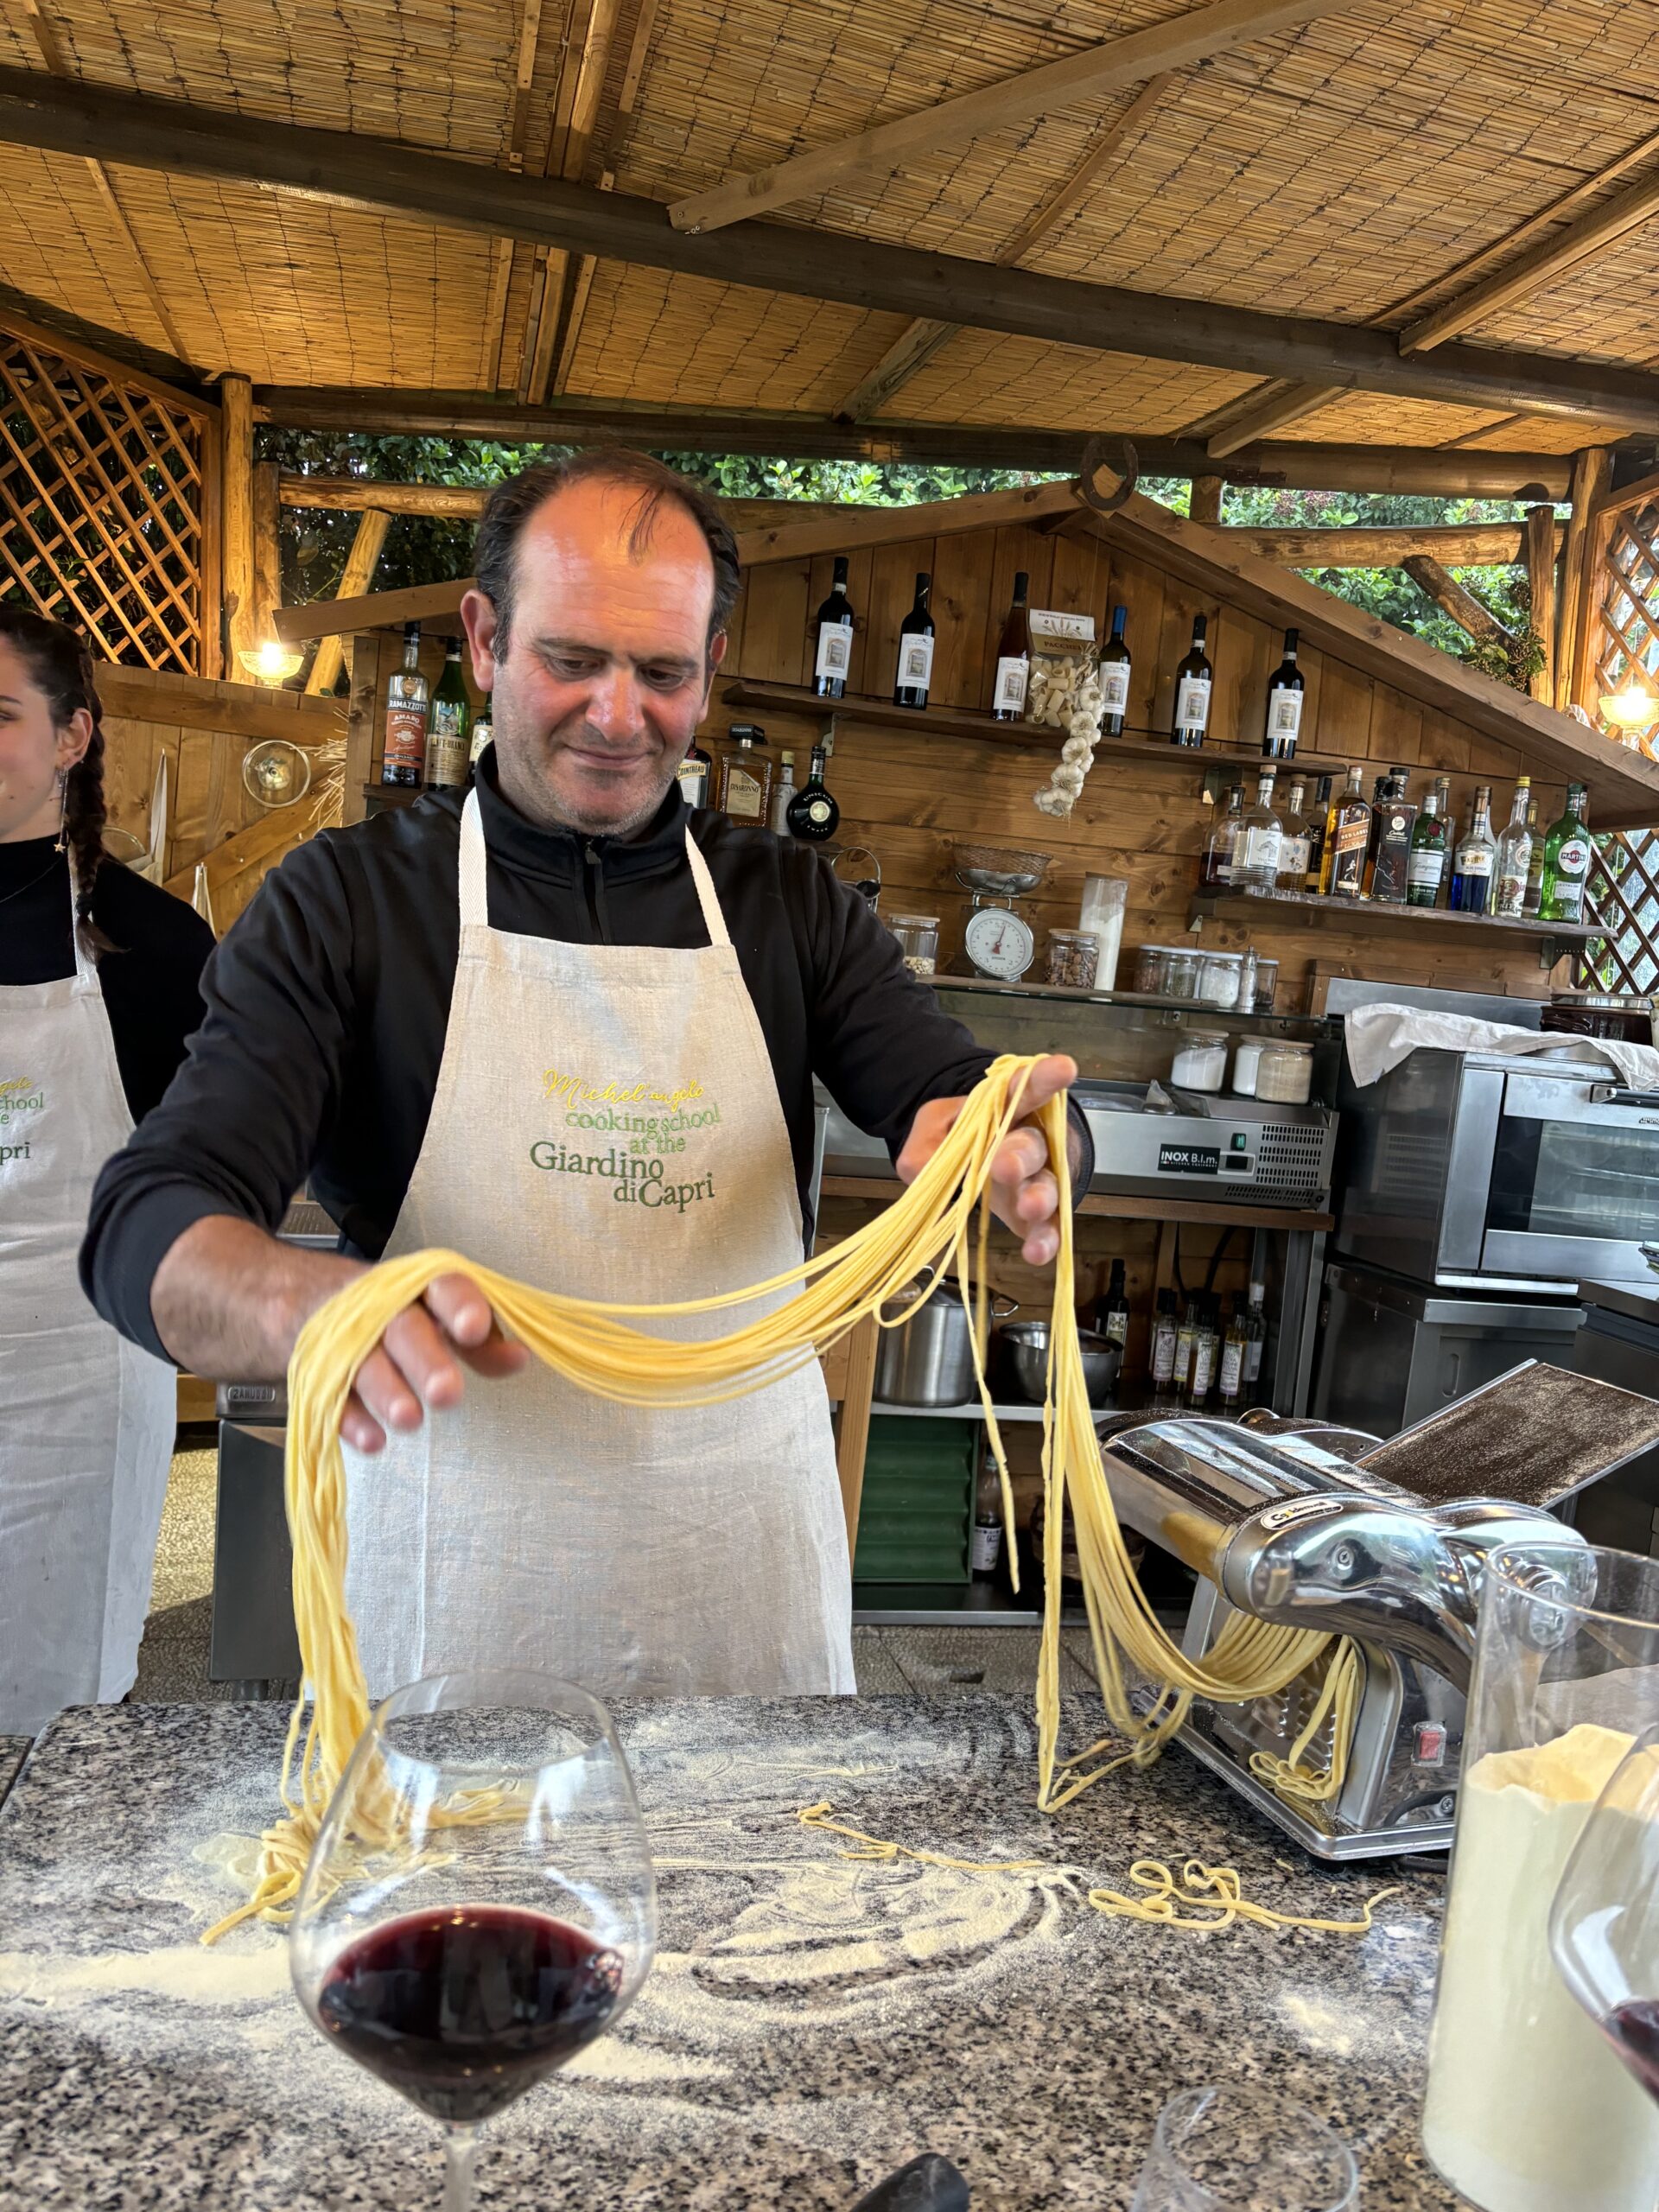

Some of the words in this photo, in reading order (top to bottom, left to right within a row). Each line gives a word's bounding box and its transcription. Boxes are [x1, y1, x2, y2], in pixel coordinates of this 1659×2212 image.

[394, 714, 420, 723] AMARO
[803, 792, 833, 804] UNICUM
[629, 1136, 650, 1155] at
[656, 1130, 687, 1154] the
[529, 1141, 664, 1179] Giardino
[1160, 1151, 1189, 1162] INOX
